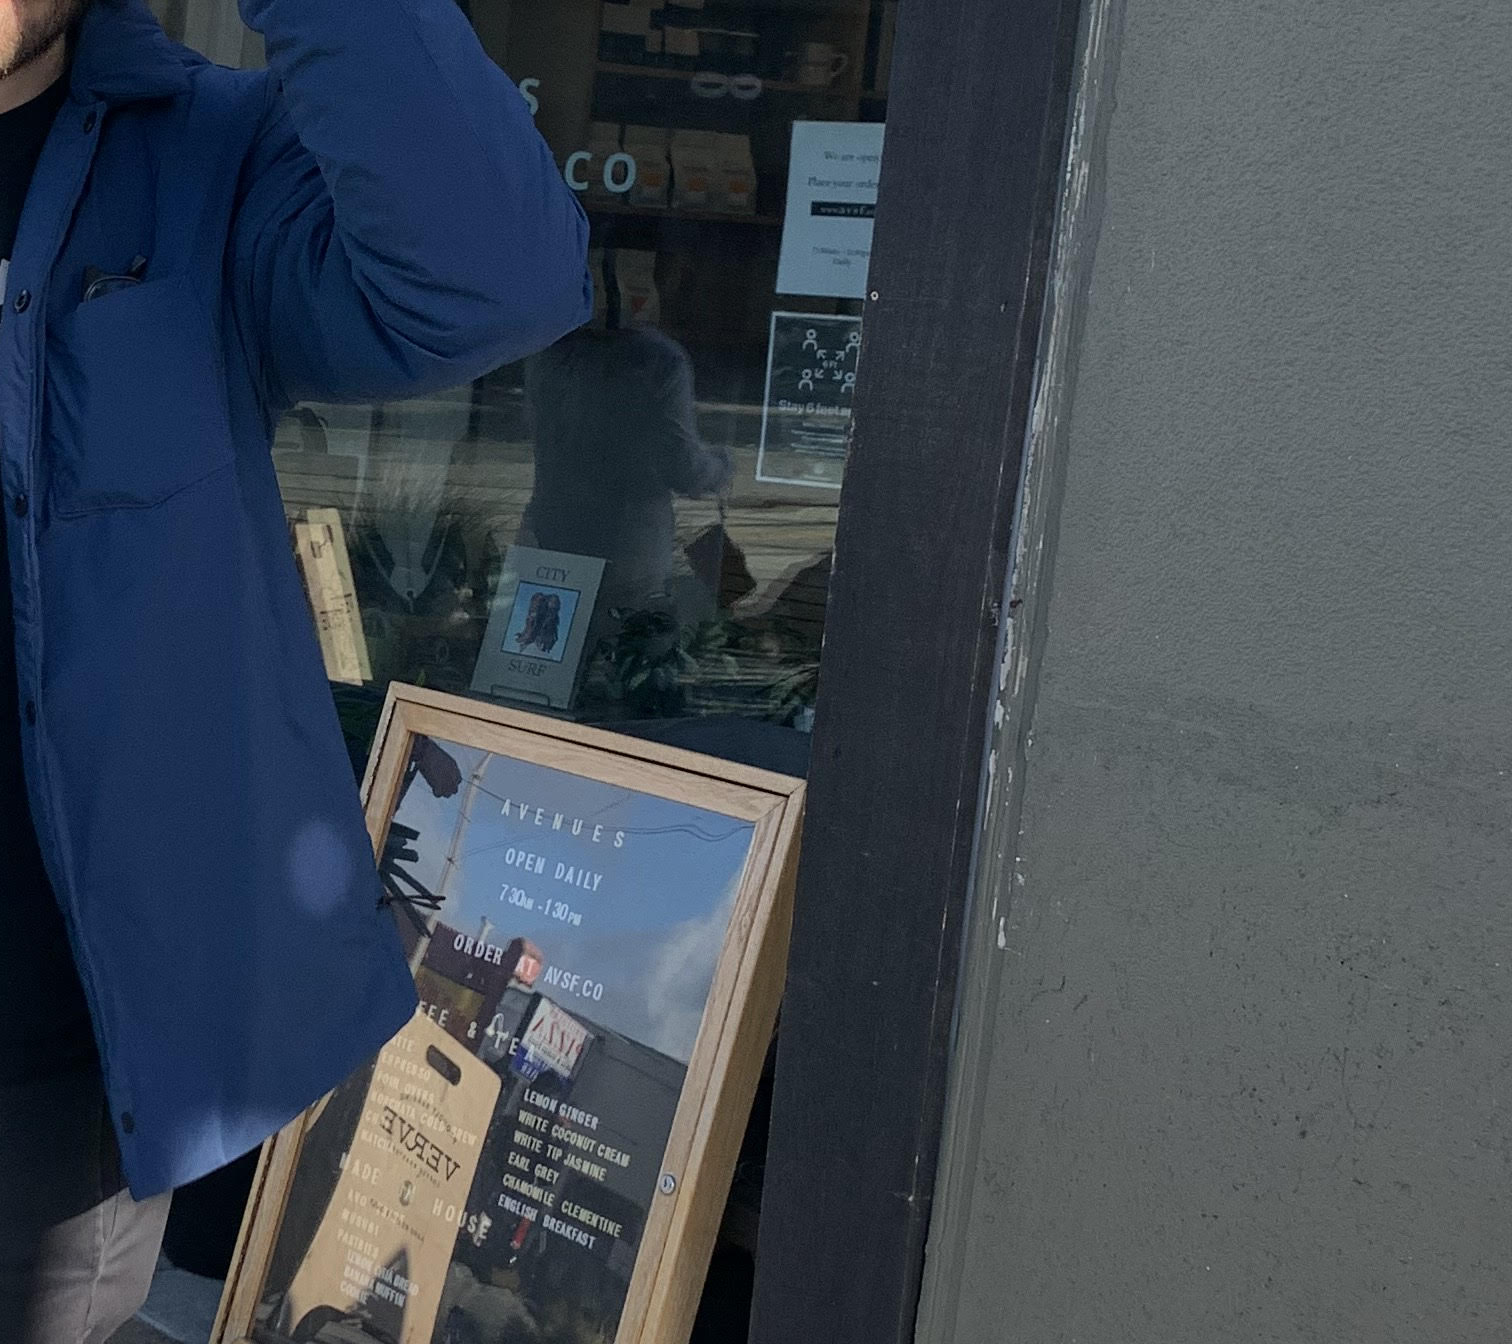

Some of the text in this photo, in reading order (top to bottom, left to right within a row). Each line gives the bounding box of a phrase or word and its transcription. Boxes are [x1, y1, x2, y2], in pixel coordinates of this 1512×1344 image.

[536, 566, 570, 583] CITY
[508, 658, 548, 677] SURF
[501, 798, 625, 848] AVENUES
[505, 848, 603, 892] OPEN DAILY
[453, 934, 604, 1001] ORDER AT AVSF.CO
[523, 1088, 599, 1131] LEMON GINGER
[514, 1129, 607, 1182] WHITE TIP JASMINE
[518, 1109, 631, 1168] WHITE COCONUT CREAM
[508, 1151, 560, 1185] EARL GREY
[432, 1197, 490, 1240] HOUSE
[498, 1193, 597, 1249] ENGLISH BREAKFAST
[502, 1173, 623, 1238] CHAMOMILE CLEMENTINE
